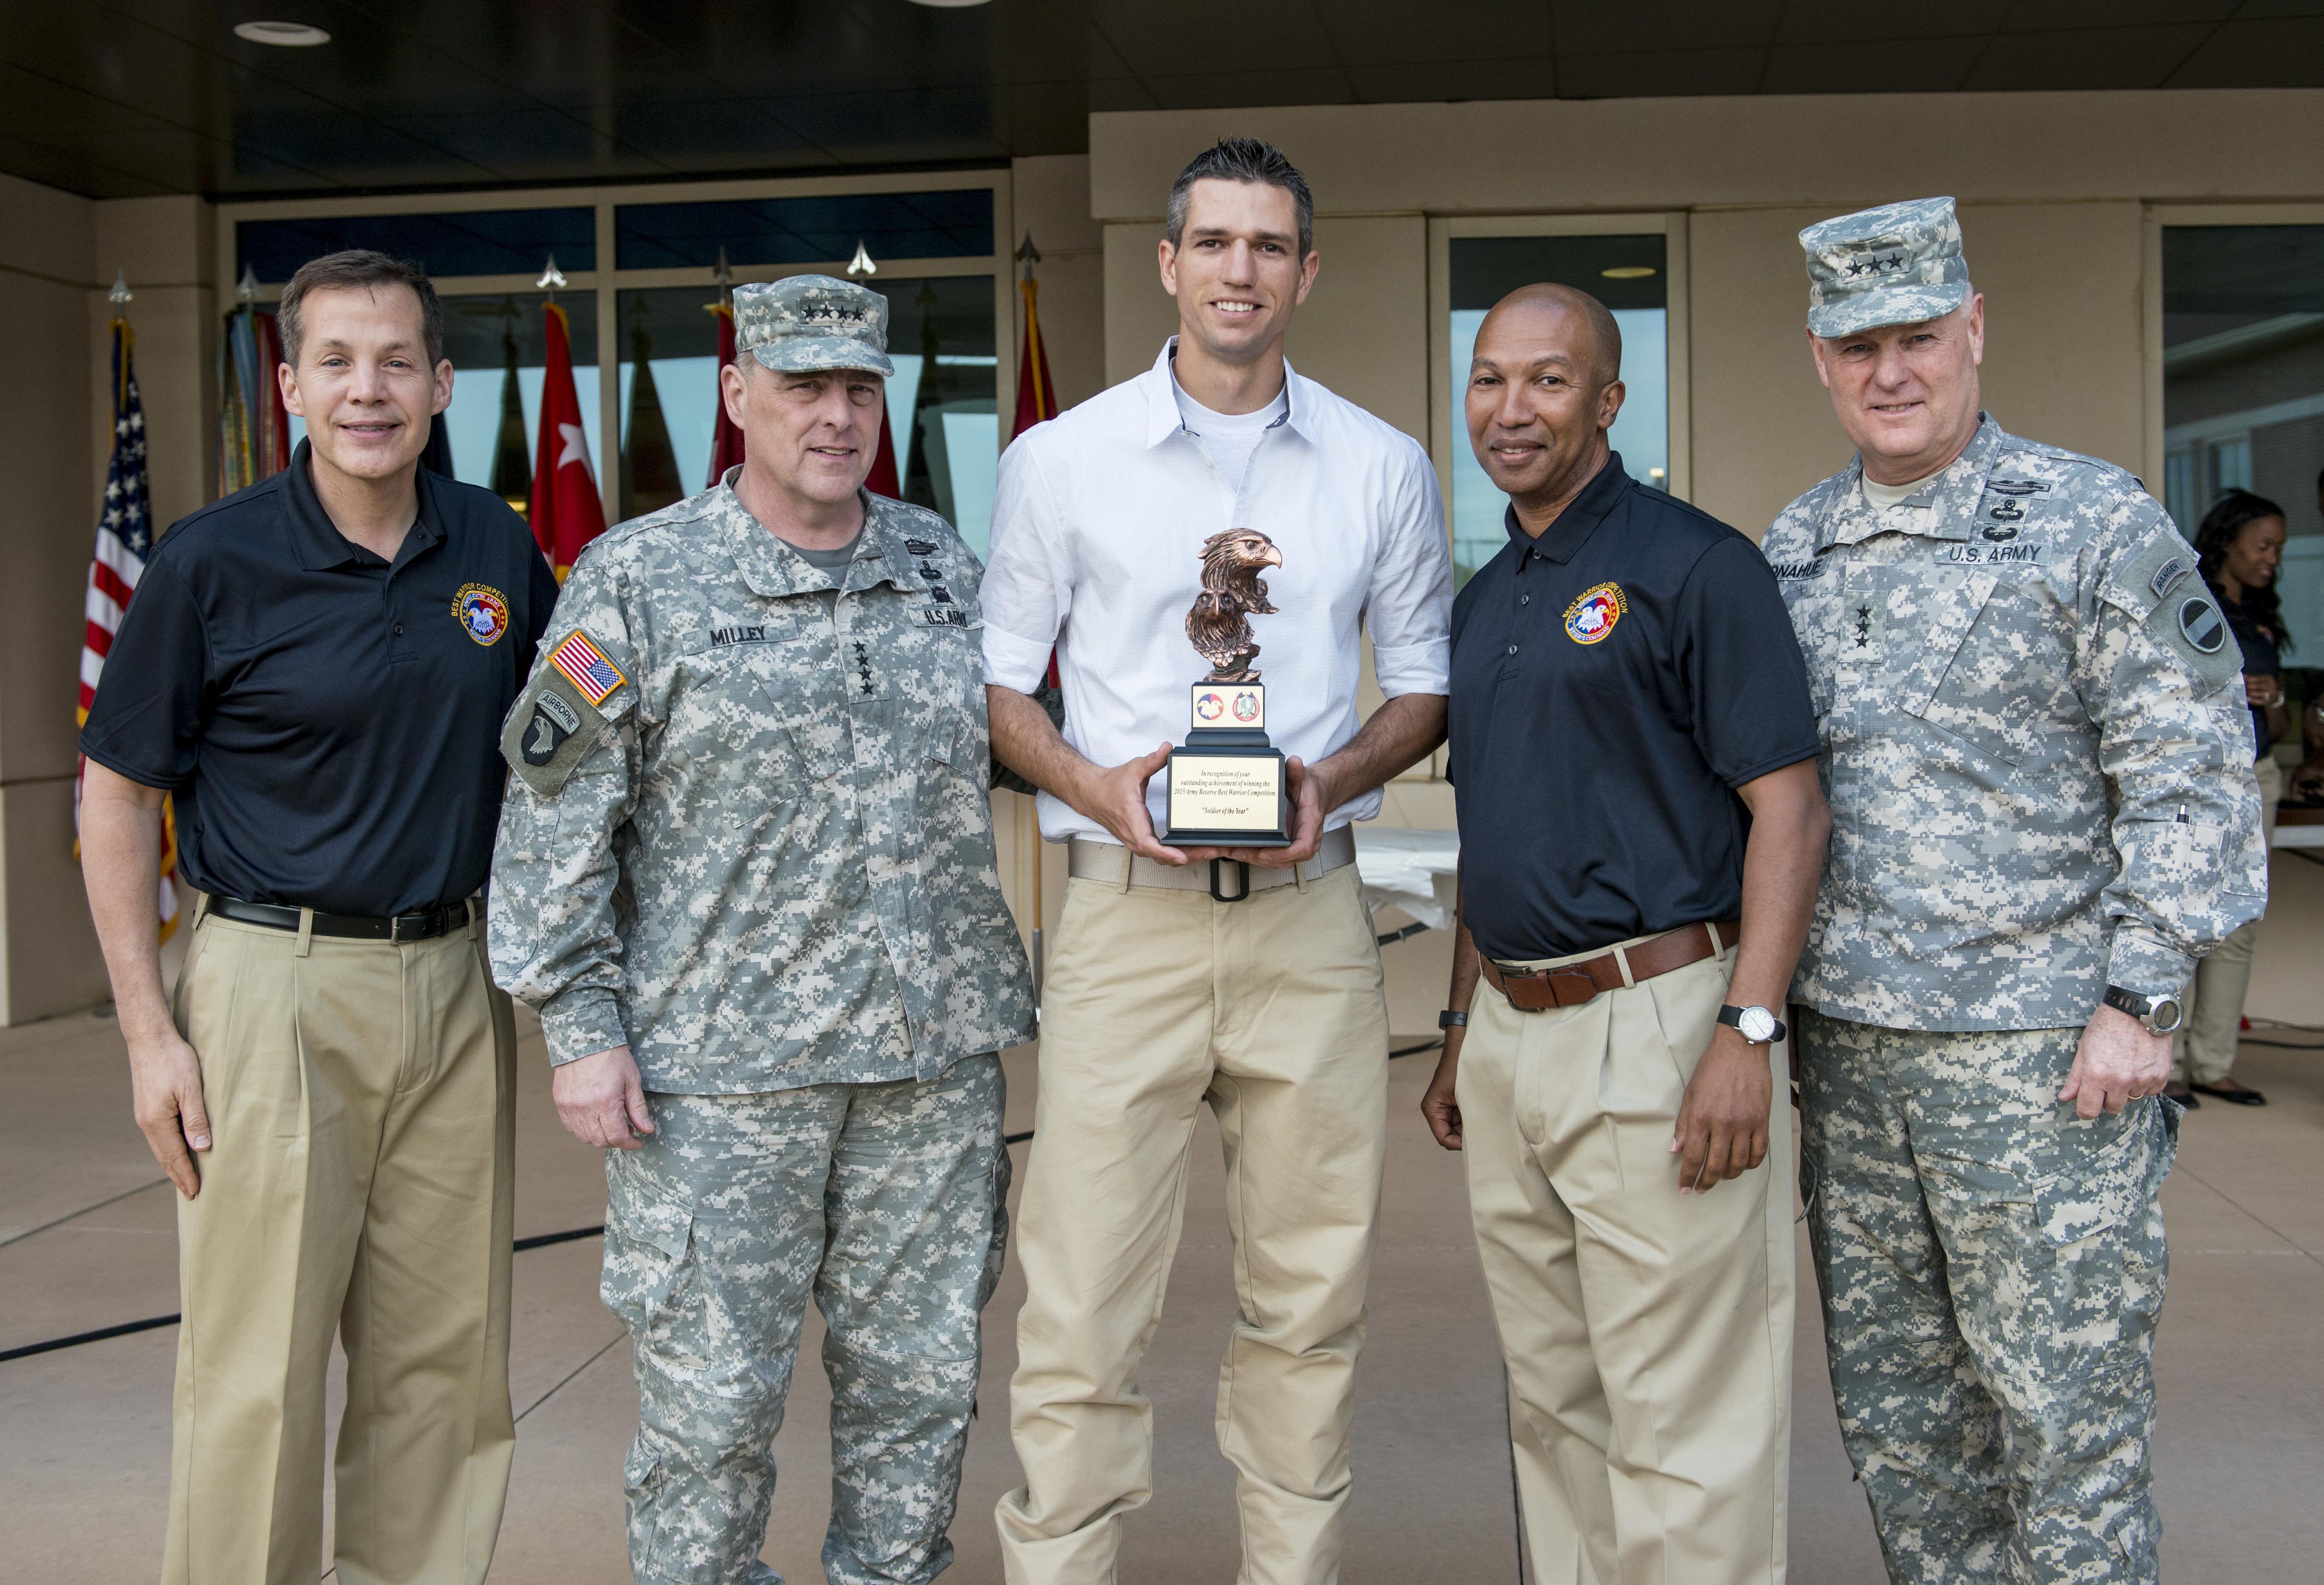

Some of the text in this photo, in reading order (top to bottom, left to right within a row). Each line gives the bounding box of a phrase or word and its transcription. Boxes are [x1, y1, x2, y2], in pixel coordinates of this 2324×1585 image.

[1949, 545, 2042, 562] U.S. ARMY
[2157, 562, 2180, 589] RANGER
[451, 583, 511, 616] BEST WARRIOR COMPETITI
[486, 597, 501, 608] ARMY
[1562, 581, 1628, 618] BEST WARRIOR COMPETITION
[924, 610, 968, 628] U.S. ARMY
[709, 626, 765, 646] MILLEY
[1569, 625, 1609, 641] RESERVE COMMAND
[541, 694, 576, 728] AIRBORNE
[1247, 789, 1276, 798] Competition.
